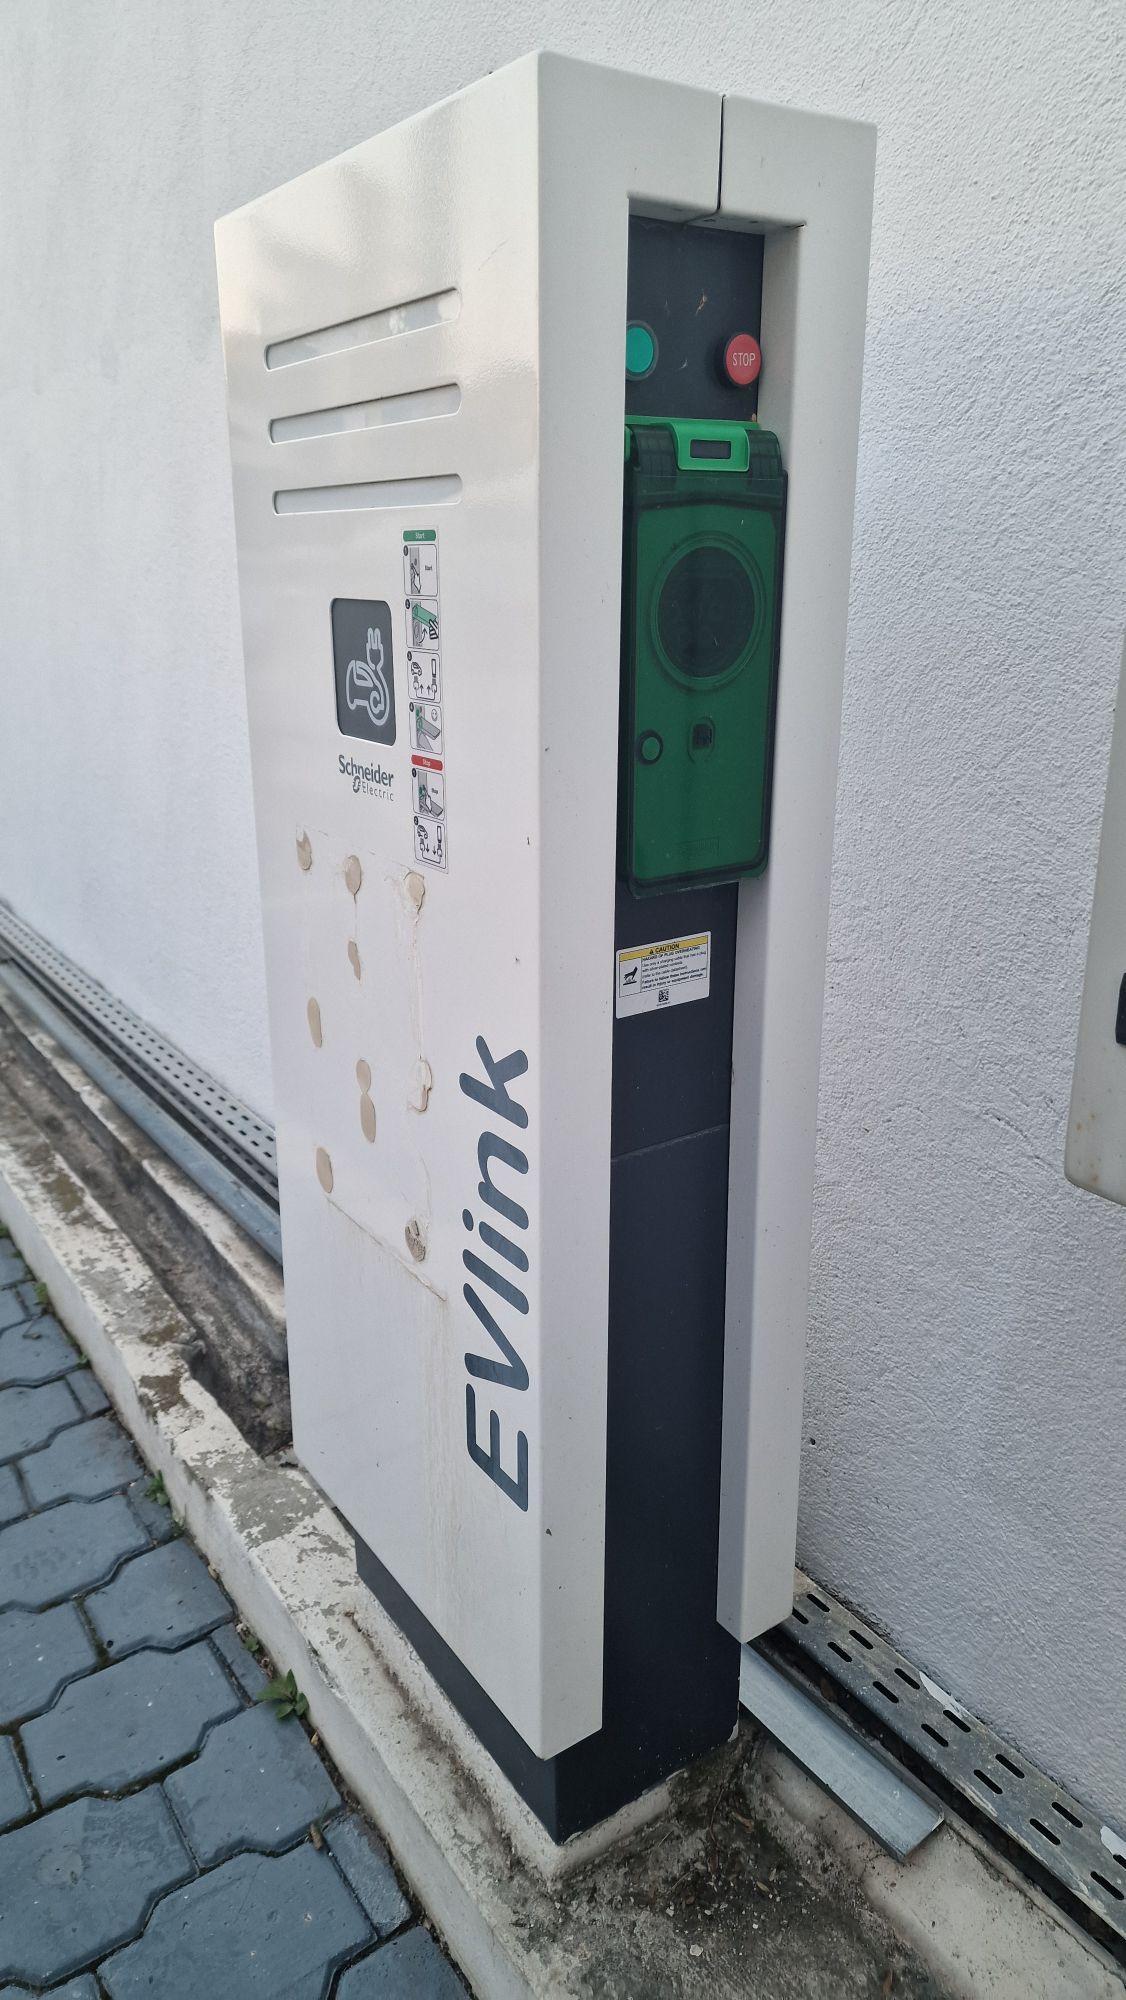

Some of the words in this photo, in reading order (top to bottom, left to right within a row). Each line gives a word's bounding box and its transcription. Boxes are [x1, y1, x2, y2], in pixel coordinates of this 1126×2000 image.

[732, 352, 756, 367] STOP
[415, 532, 425, 540] Start
[338, 754, 394, 787] Schneider
[422, 758, 431, 768] Stop
[361, 780, 394, 801] Electric
[655, 943, 679, 953] CAUTION
[459, 1035, 529, 1512] EVlink
